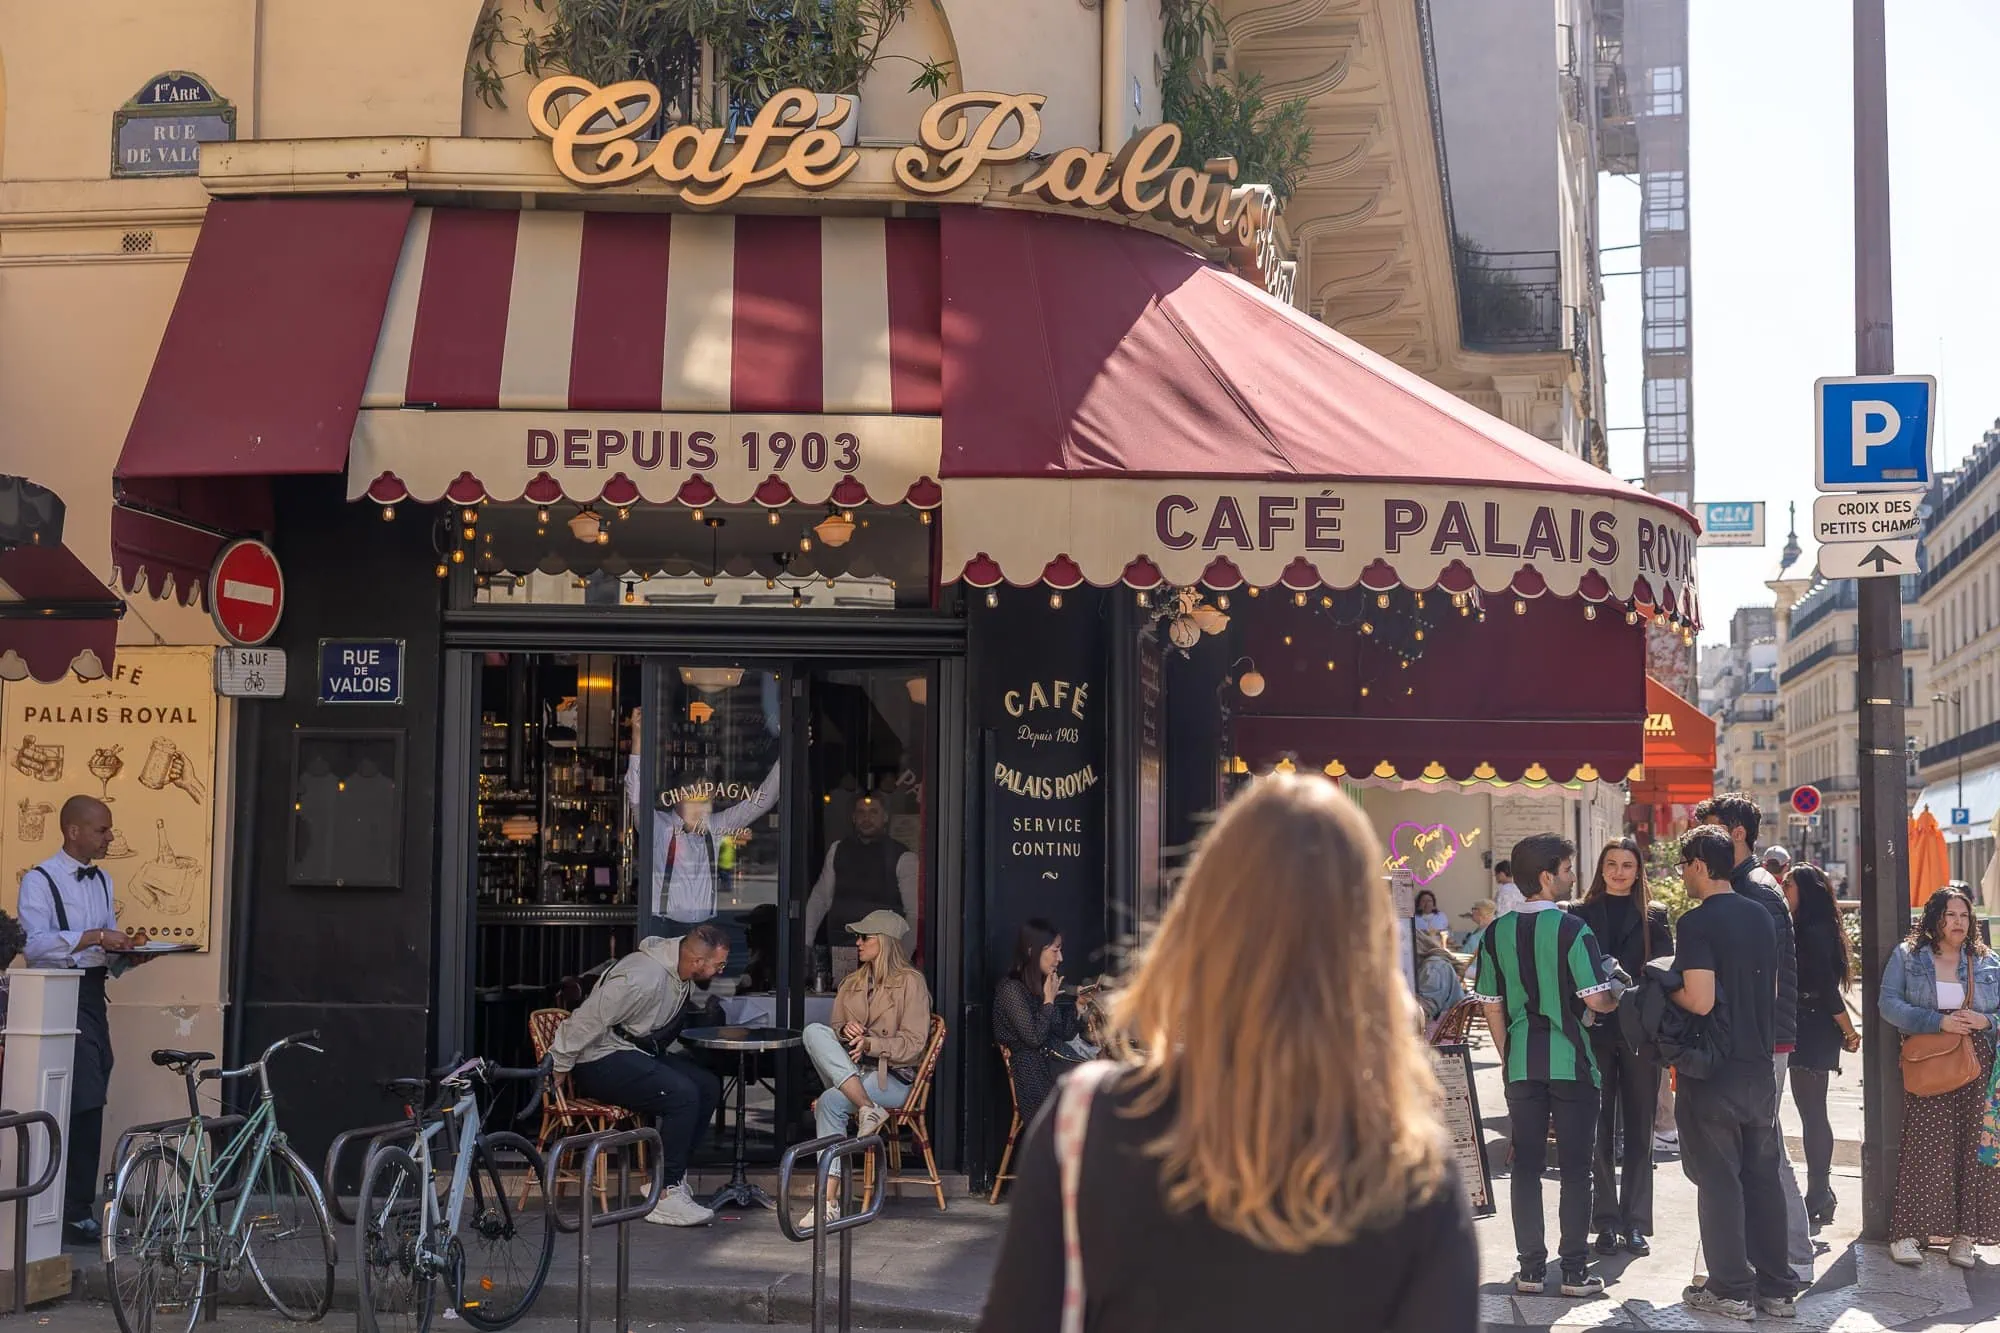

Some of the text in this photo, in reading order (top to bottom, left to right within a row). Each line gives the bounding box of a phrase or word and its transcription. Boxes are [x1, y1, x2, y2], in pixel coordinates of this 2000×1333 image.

[154, 125, 196, 140] RUE
[127, 148, 151, 163] DE
[527, 75, 859, 206] Café
[894, 90, 1256, 248] Palais
[1852, 400, 1901, 466] P
[527, 429, 861, 473] DEPUIS 1903
[1838, 501, 1912, 516] CROIX DES
[1156, 489, 1345, 552] CAFÉ
[1384, 499, 1620, 565] PALAIS
[1821, 521, 1867, 535] PETITS
[241, 652, 268, 666] SAUF
[343, 650, 380, 665] RUE
[354, 667, 368, 676] DE
[329, 677, 391, 693] VALOIS
[1004, 680, 1089, 721] CAFÉ
[24, 707, 198, 723] PALAIS ROYAL
[1017, 724, 1079, 749] Depuis 1903
[994, 762, 1099, 800] PALAIS ROYAL
[660, 782, 768, 809] CHAMPAGNE
[1012, 817, 1082, 832] SERVICE
[1012, 842, 1081, 857] CONTINU
